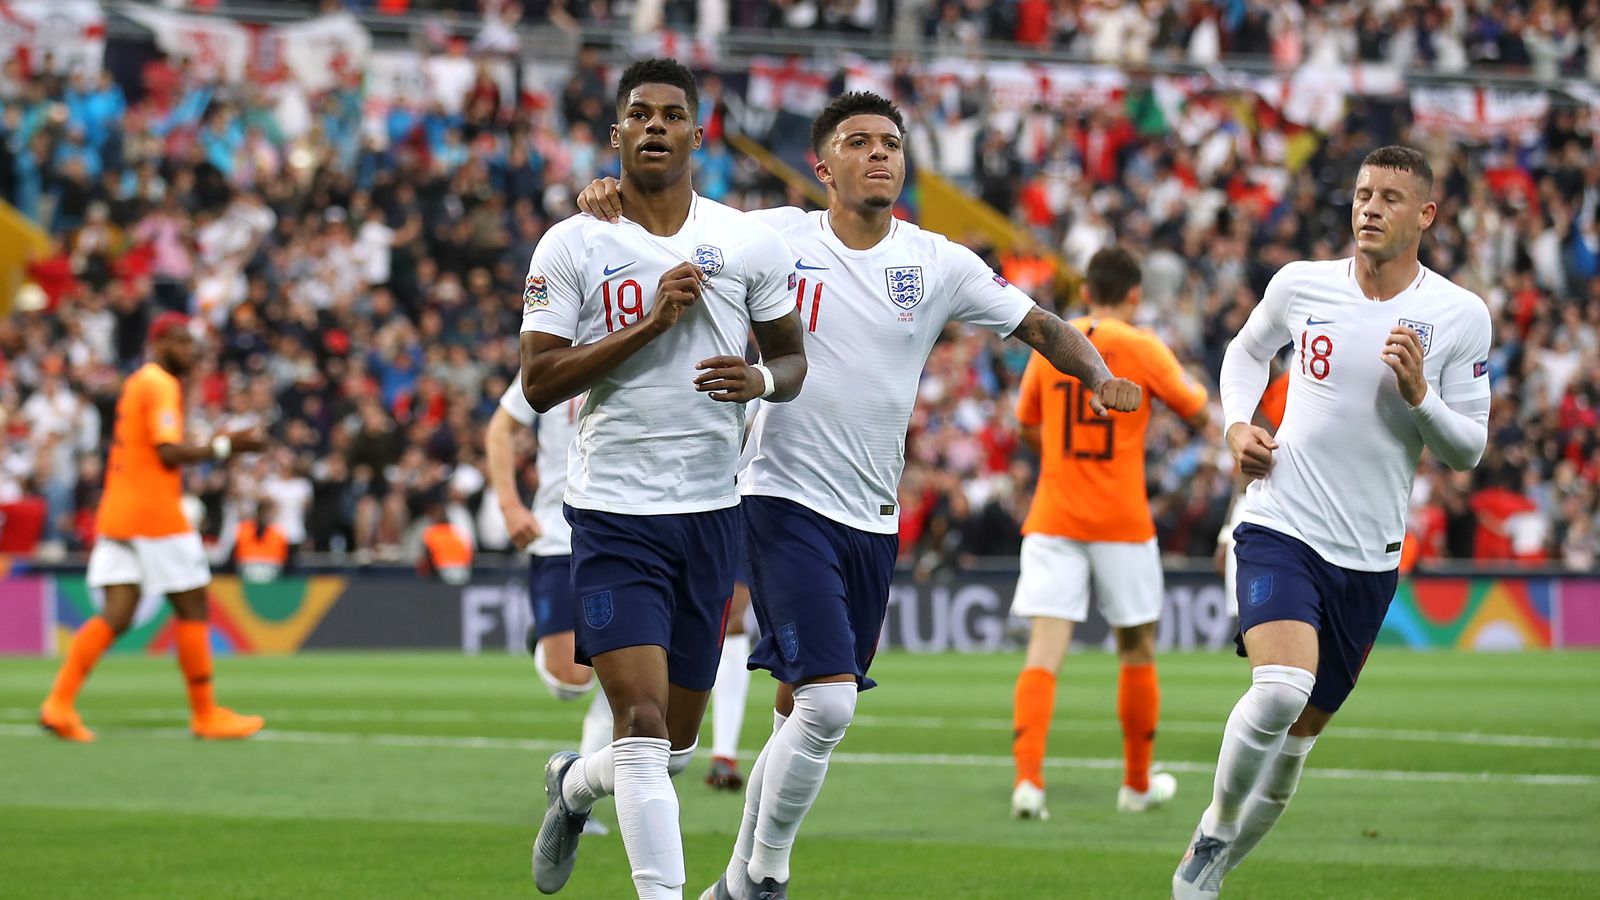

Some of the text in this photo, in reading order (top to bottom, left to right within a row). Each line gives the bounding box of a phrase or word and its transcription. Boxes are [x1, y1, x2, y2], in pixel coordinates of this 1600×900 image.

[602, 279, 644, 333] 19
[796, 277, 824, 333] 11
[1300, 330, 1333, 381] 18
[1053, 380, 1116, 461] 15
